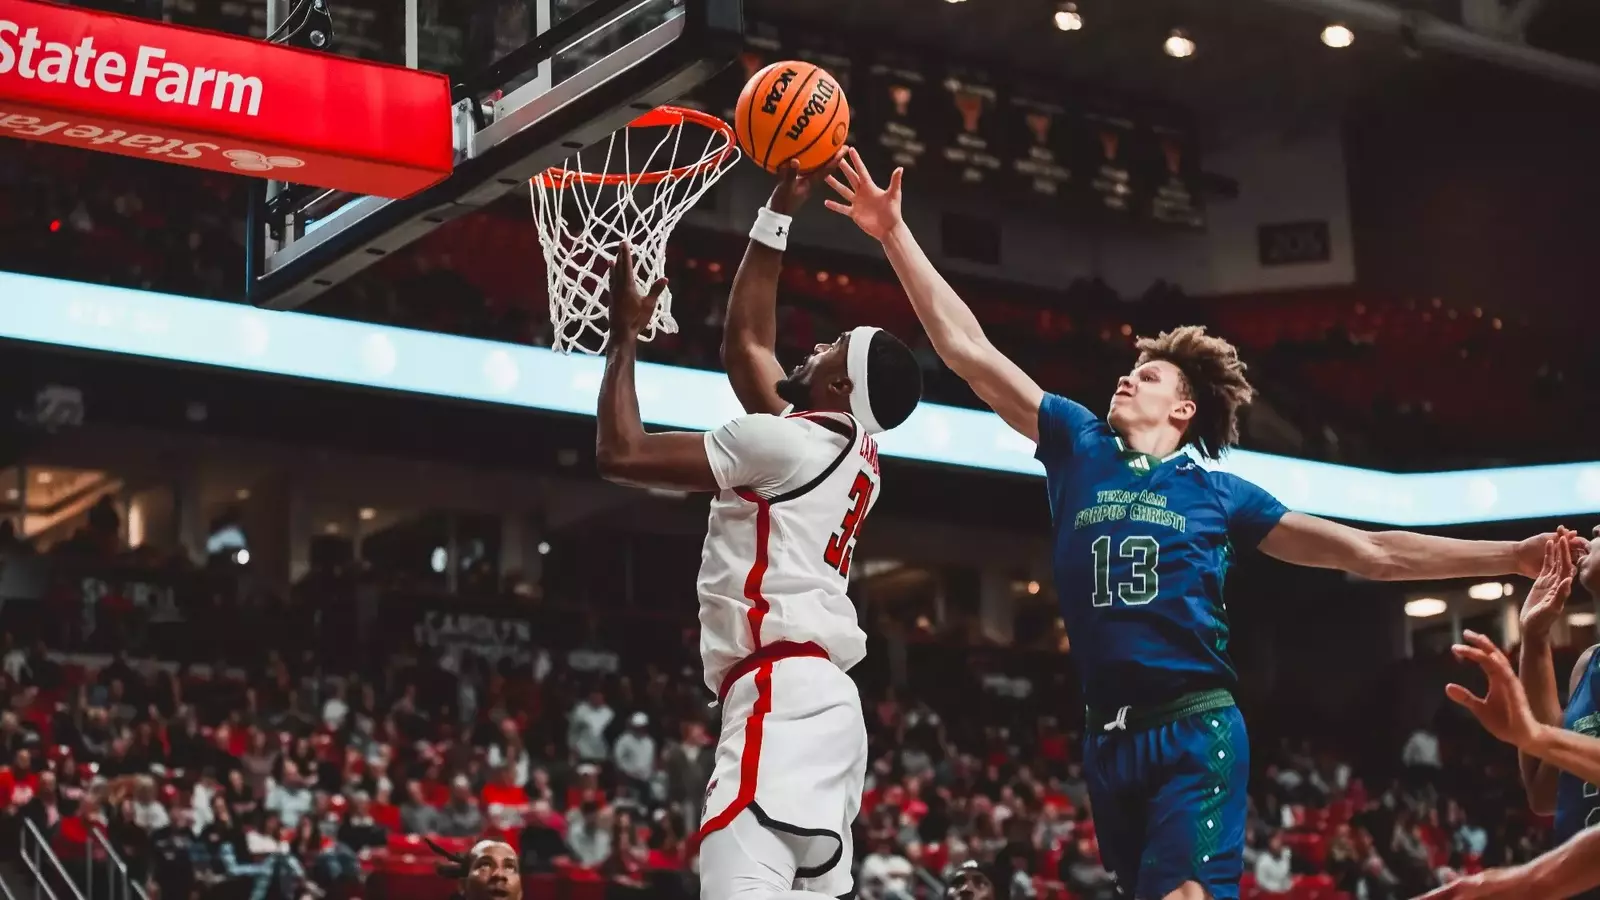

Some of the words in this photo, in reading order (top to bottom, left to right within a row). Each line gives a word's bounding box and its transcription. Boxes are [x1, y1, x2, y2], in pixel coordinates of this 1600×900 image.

[762, 68, 798, 116] NCAA
[785, 78, 835, 141] Wilson
[1075, 504, 1127, 530] CORPUS
[1129, 503, 1186, 534] CHRISTI
[1139, 489, 1167, 508] A&M
[1091, 535, 1160, 608] 13
